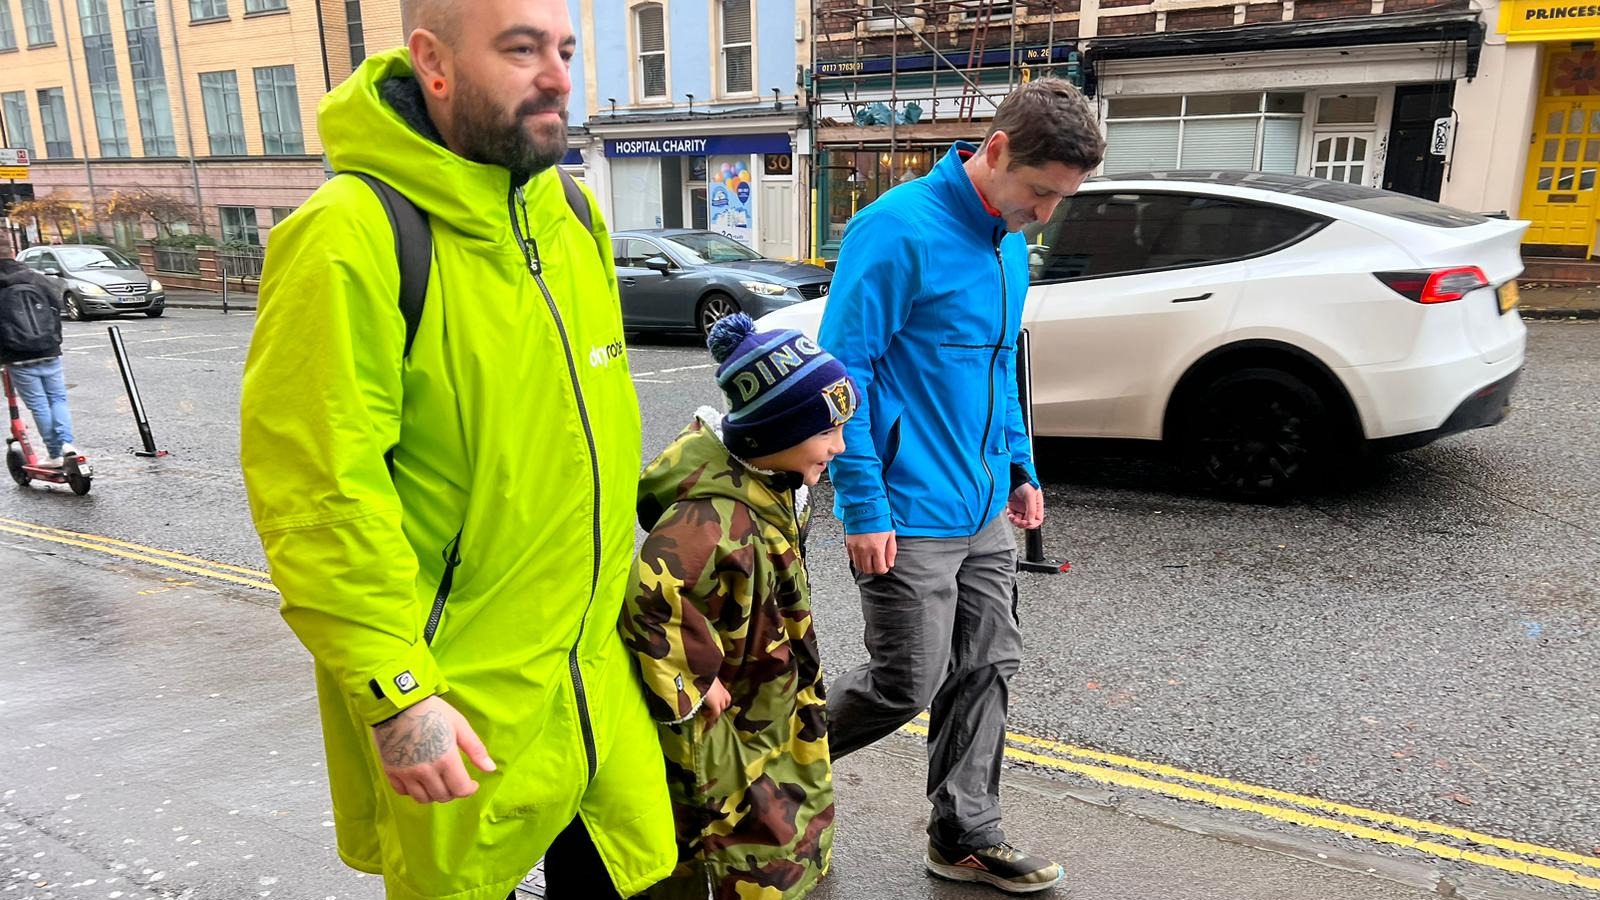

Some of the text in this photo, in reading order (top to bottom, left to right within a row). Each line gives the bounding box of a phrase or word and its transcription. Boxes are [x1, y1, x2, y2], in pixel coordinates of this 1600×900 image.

[1028, 50, 1039, 58] No.
[821, 64, 837, 72] 0117
[616, 139, 707, 154] HOSPITAL CHARITY
[768, 154, 791, 170] 30
